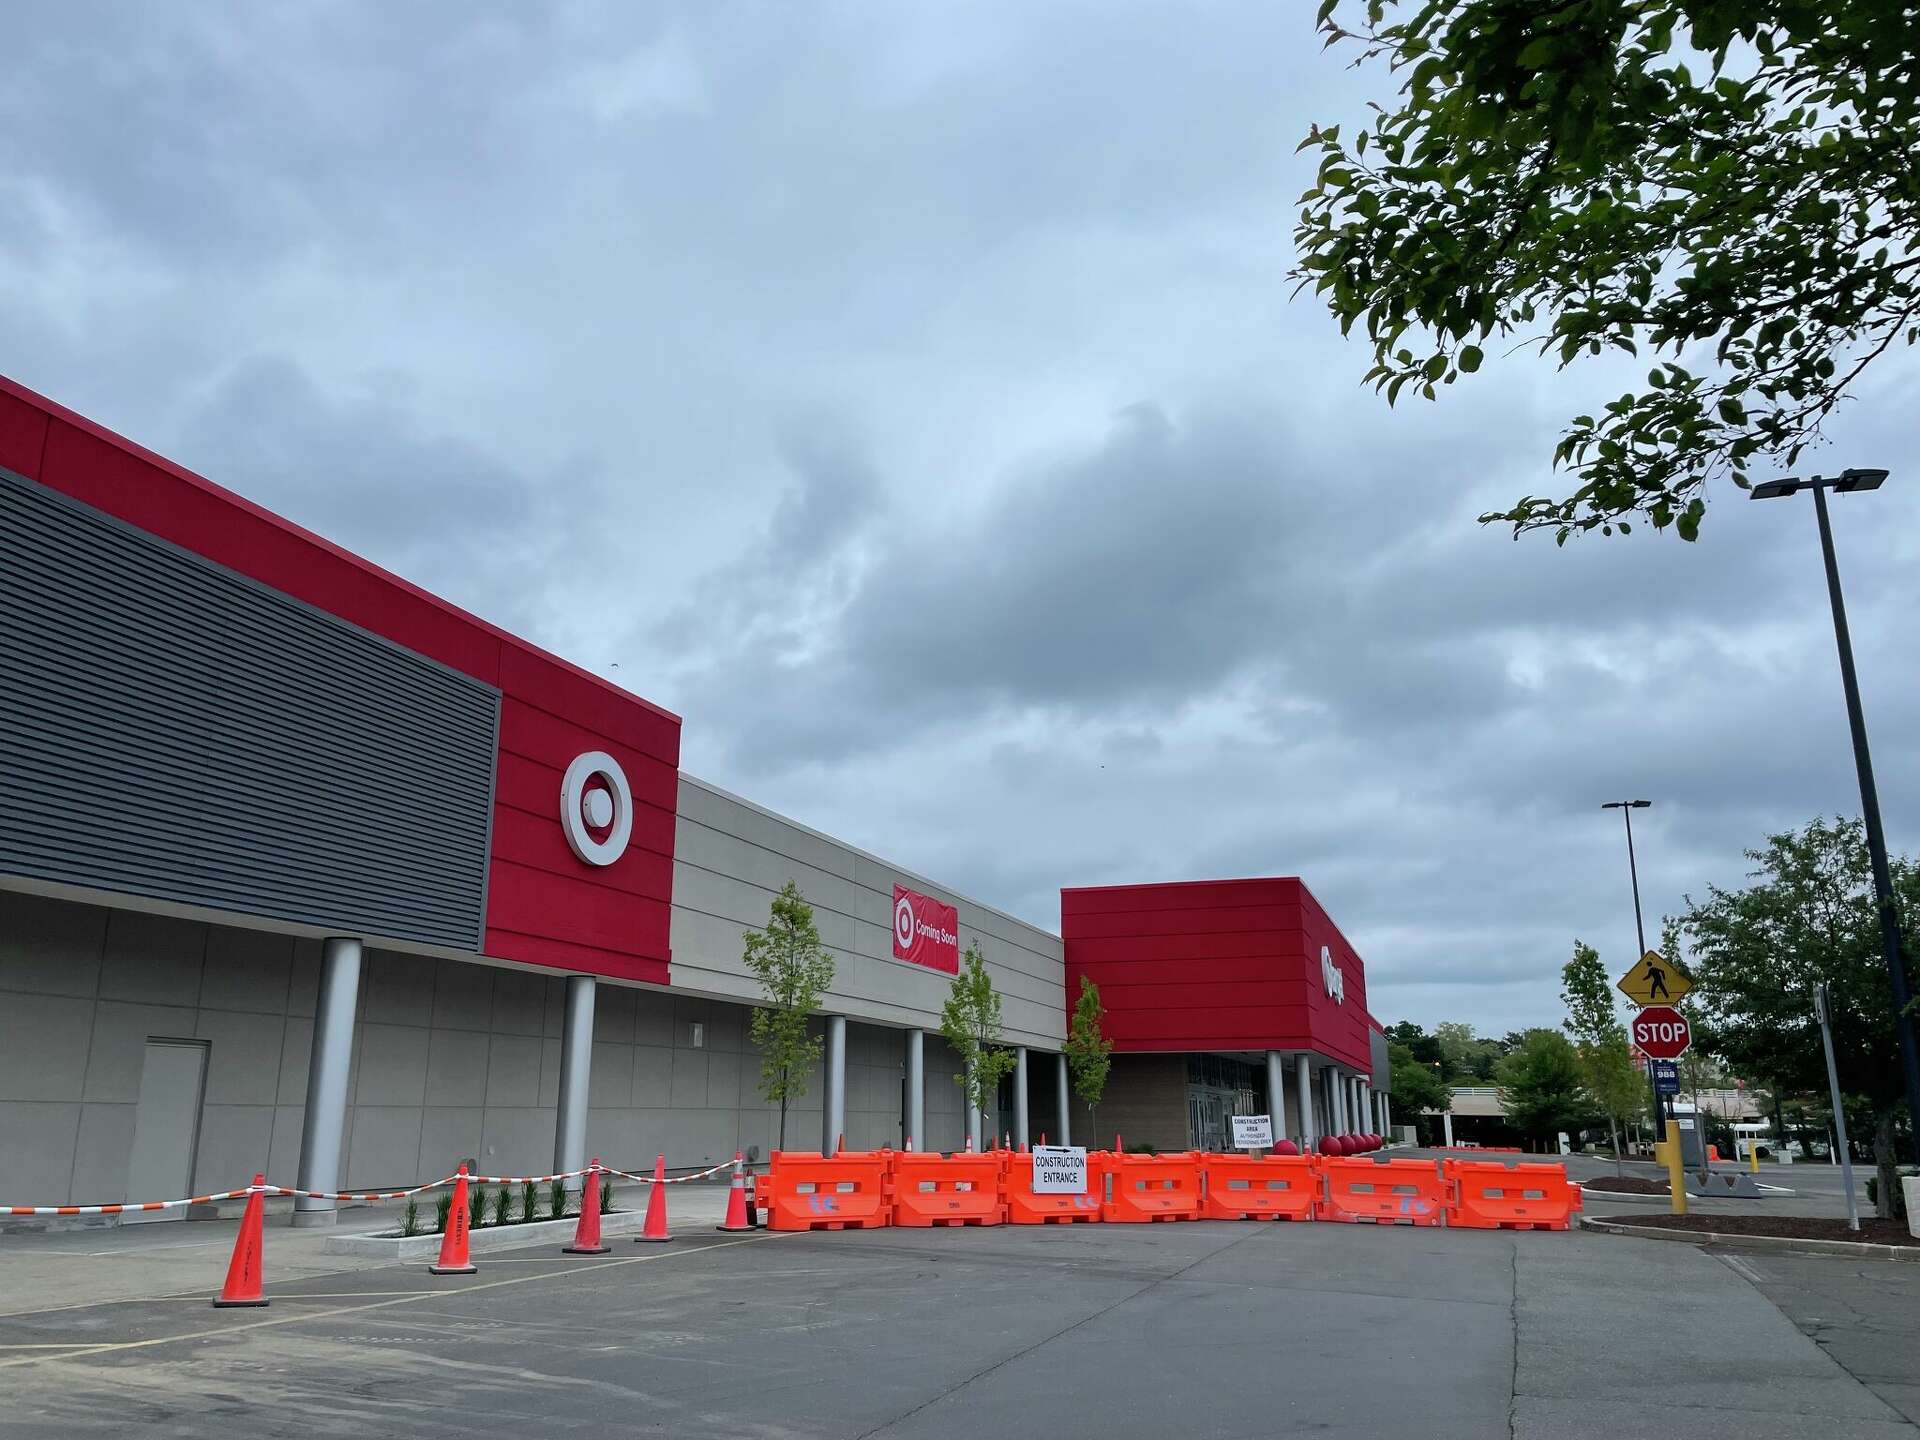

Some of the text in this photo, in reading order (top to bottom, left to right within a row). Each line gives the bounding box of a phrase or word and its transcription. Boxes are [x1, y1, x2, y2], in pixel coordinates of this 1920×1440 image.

[916, 919, 957, 946] Coming Soon
[1637, 1023, 1686, 1043] STOP
[1035, 1156, 1085, 1168] CONSTRUCTION
[1043, 1172, 1078, 1183] ENTRANCE
